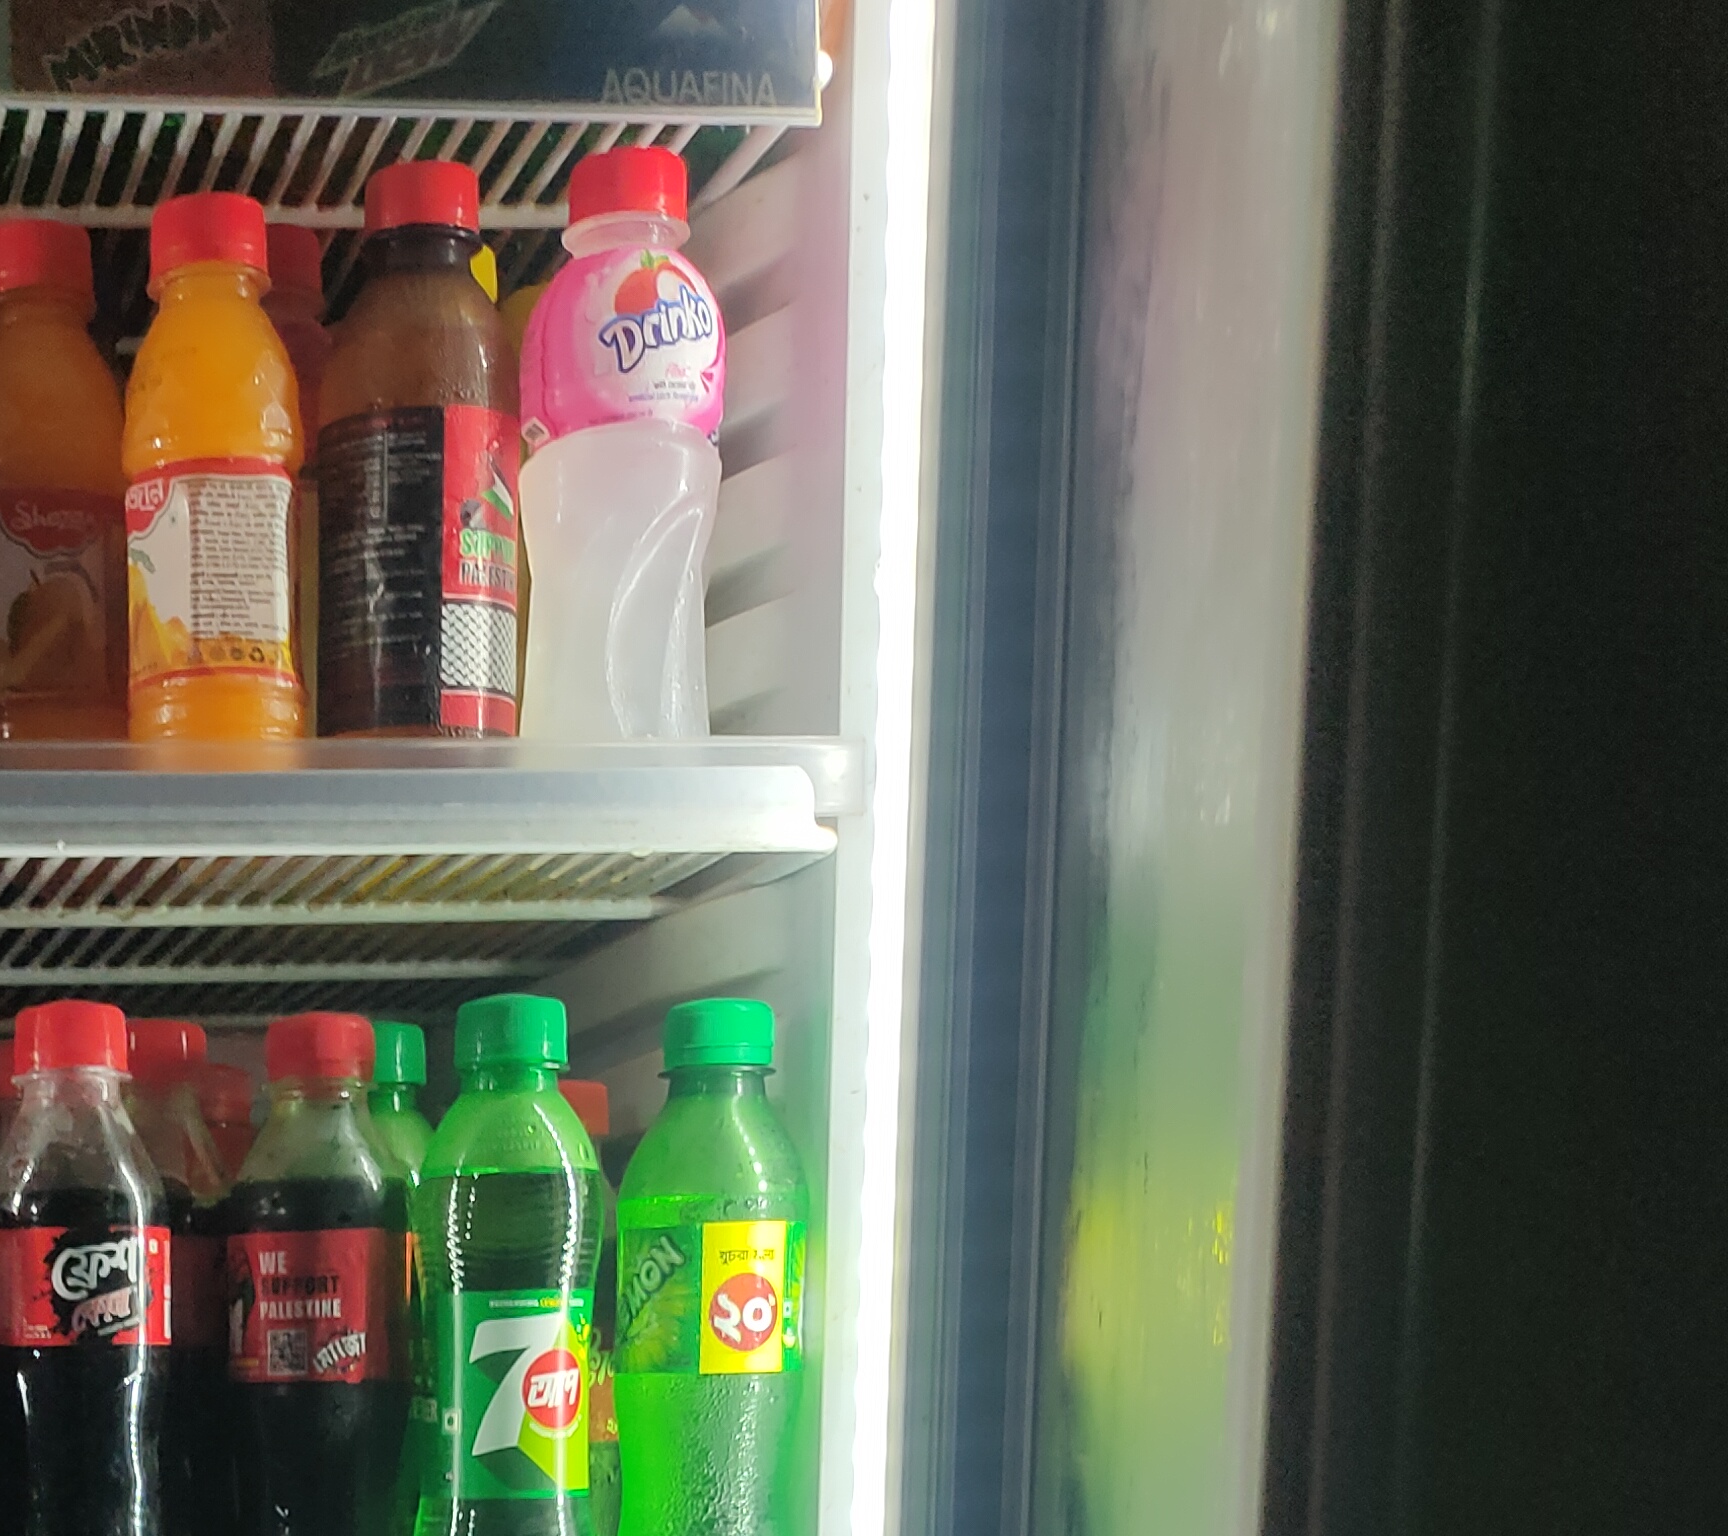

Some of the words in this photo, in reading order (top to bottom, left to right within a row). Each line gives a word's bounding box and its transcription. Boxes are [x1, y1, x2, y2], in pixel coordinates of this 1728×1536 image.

[601, 67, 777, 106] AQUAFINA
[598, 284, 713, 373] Drinko
[259, 1251, 288, 1275] WE
[261, 1275, 340, 1296] SUPPORT
[259, 1298, 342, 1320] PALESTINE
[468, 1311, 566, 1457] 7
[527, 1368, 580, 1409] আপ
